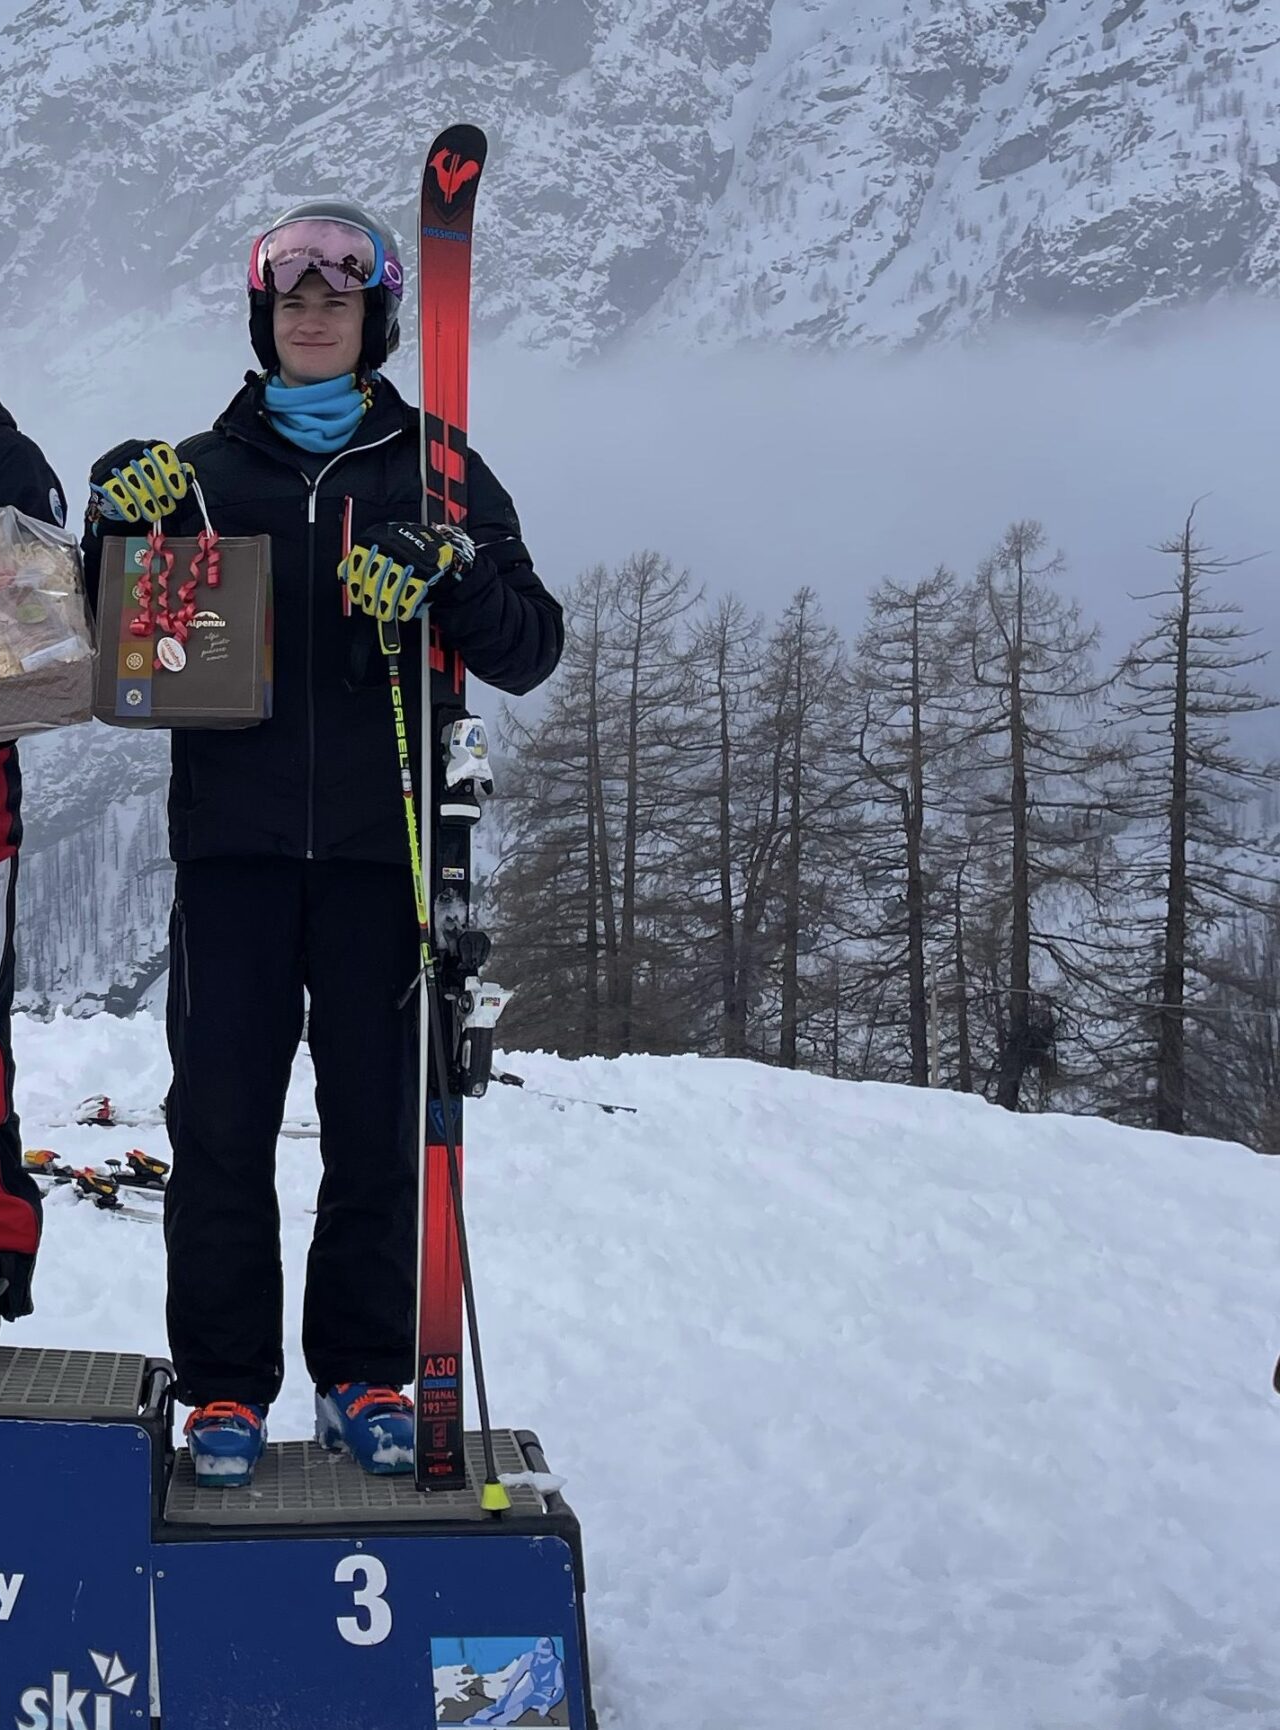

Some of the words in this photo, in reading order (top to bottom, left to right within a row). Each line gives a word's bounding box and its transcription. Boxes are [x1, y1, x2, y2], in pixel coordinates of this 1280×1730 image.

[398, 528, 426, 551] LEVEL
[391, 685, 409, 768] GABEL
[424, 1356, 457, 1377] A30
[423, 1390, 457, 1400] TITANAL
[423, 1402, 440, 1414] 193
[334, 1553, 393, 1646] 3
[16, 1670, 114, 1730] ski
